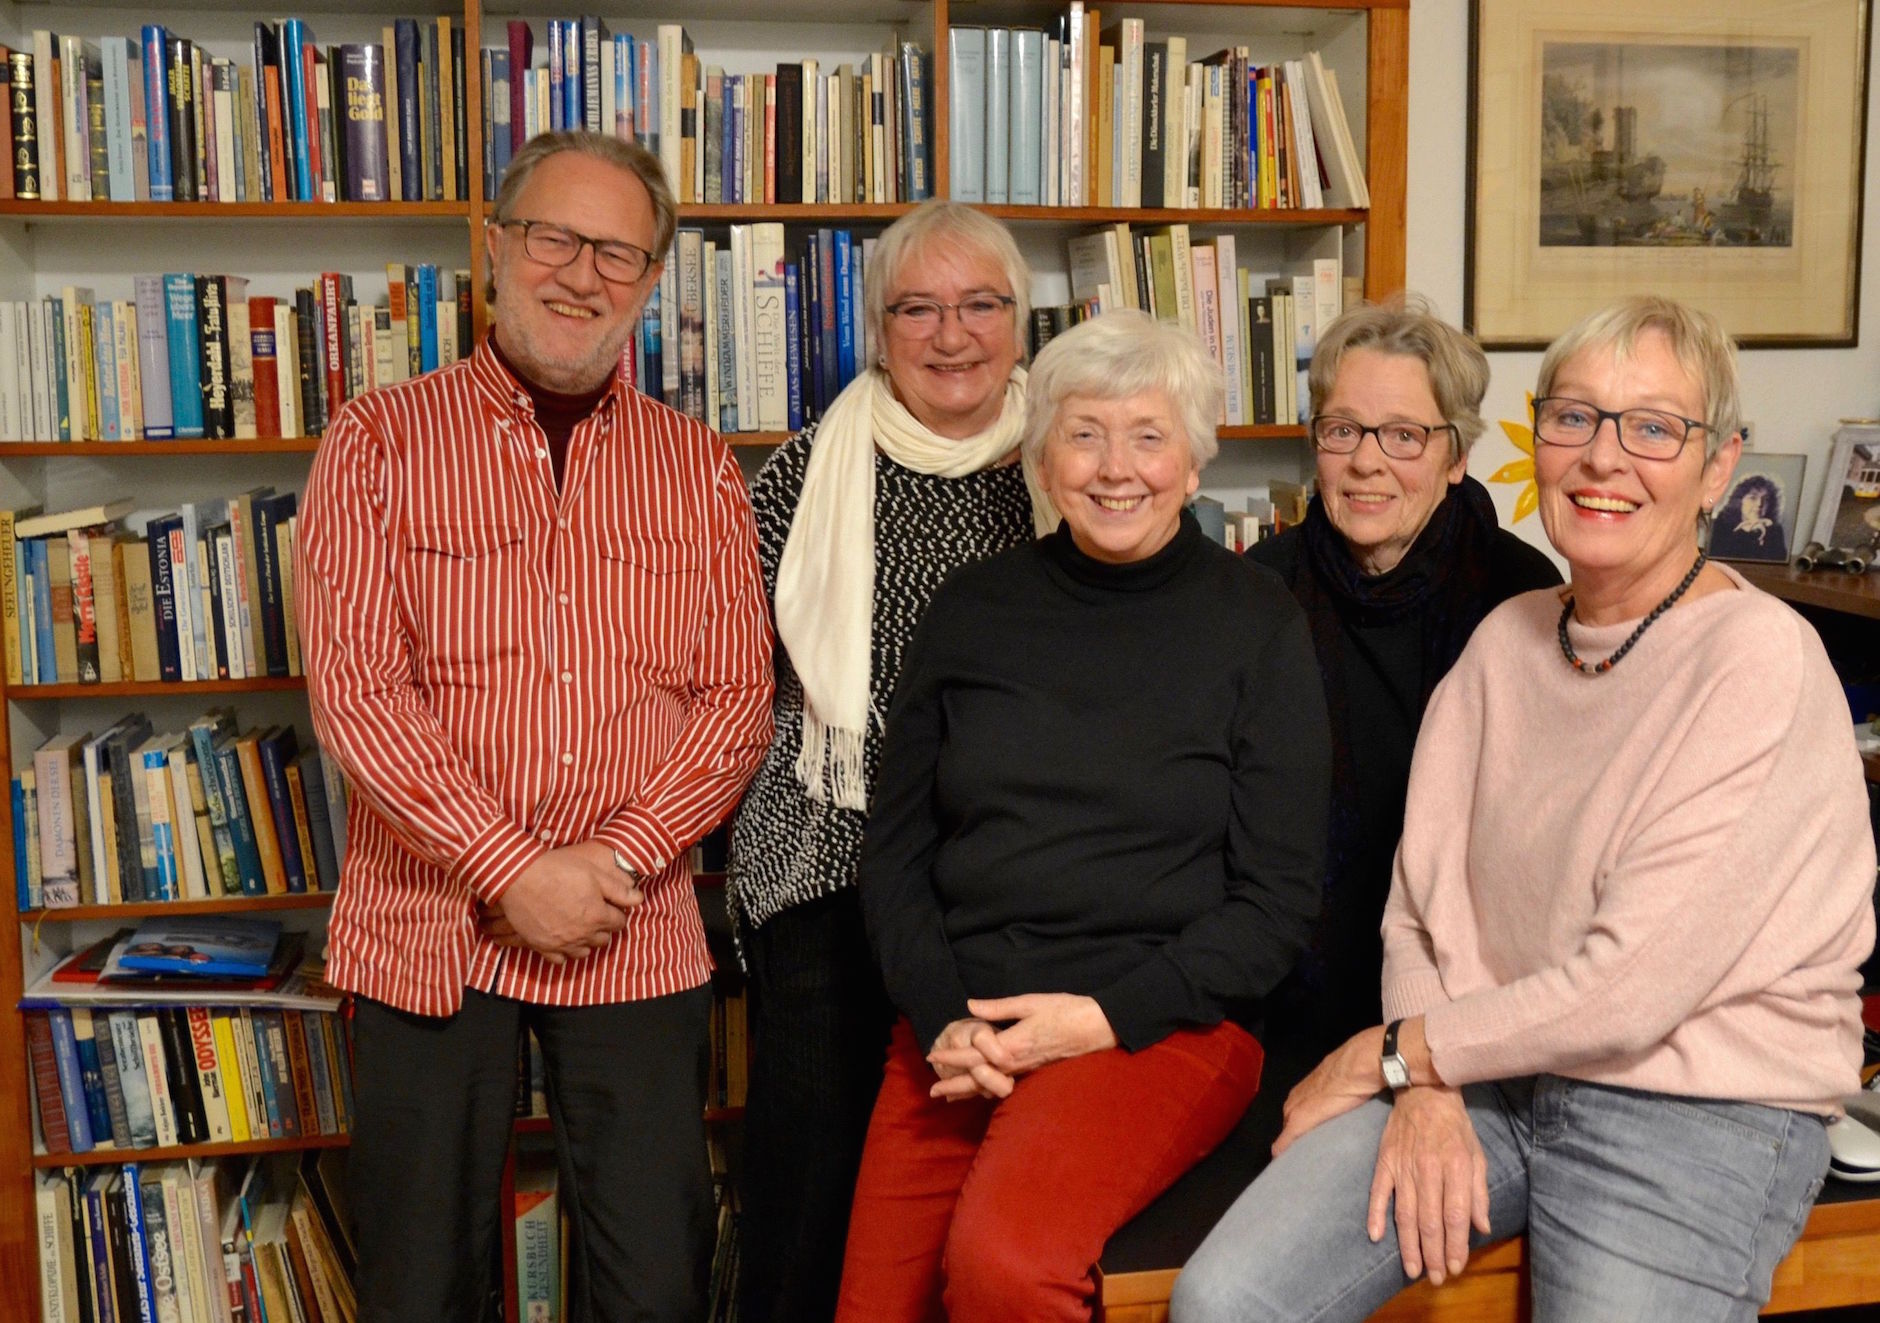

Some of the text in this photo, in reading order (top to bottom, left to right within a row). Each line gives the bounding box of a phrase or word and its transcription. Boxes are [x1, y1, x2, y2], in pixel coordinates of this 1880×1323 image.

[348, 106, 382, 121] Gold
[586, 29, 599, 133] SCHLIEMANNS ERBEN
[684, 248, 698, 312] ÜBERSEE
[1205, 290, 1213, 304] Die
[325, 278, 340, 371] ORKANFAHRT
[756, 295, 780, 398] SCHIFFE
[1207, 307, 1215, 333] Juden
[1209, 335, 1216, 344] in
[206, 342, 226, 409] Heyerdahl
[788, 309, 800, 413] ATLAS SEEWESEN
[1, 518, 16, 618] SEEUNGEHEUER
[155, 535, 174, 620] DIE ESTONIA
[43, 1213, 55, 1248] SCHIFFE
[153, 1231, 172, 1290] Ostsee
[525, 1220, 538, 1300] KURSBUCH
